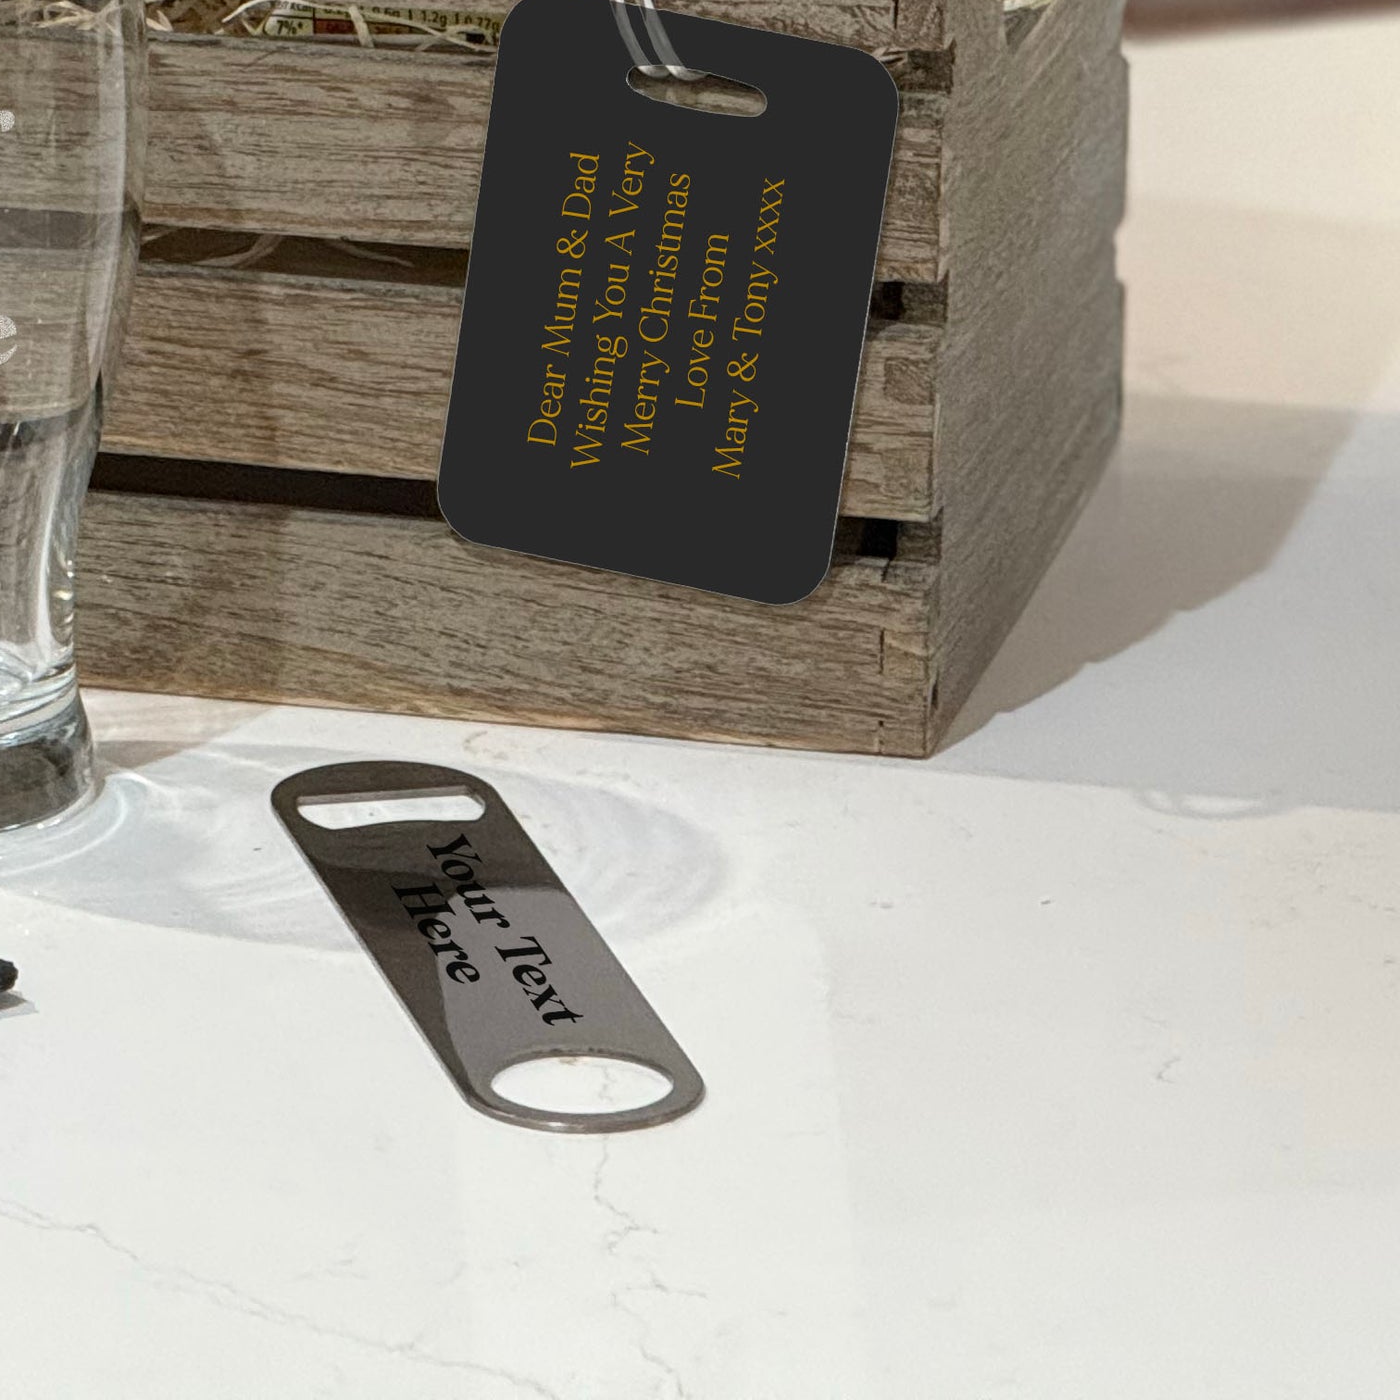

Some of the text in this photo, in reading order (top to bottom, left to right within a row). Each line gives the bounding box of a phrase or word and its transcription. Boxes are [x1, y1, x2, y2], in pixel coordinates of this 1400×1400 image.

[526, 152, 601, 446] Dear Mum & Dad
[570, 140, 656, 469] Wishing You A Very
[620, 172, 692, 456] Merry Christmas
[674, 232, 730, 409] Love From
[711, 177, 786, 480] Mary & Tony xxxx
[391, 882, 481, 985] Here
[426, 833, 584, 1026] Your Text
